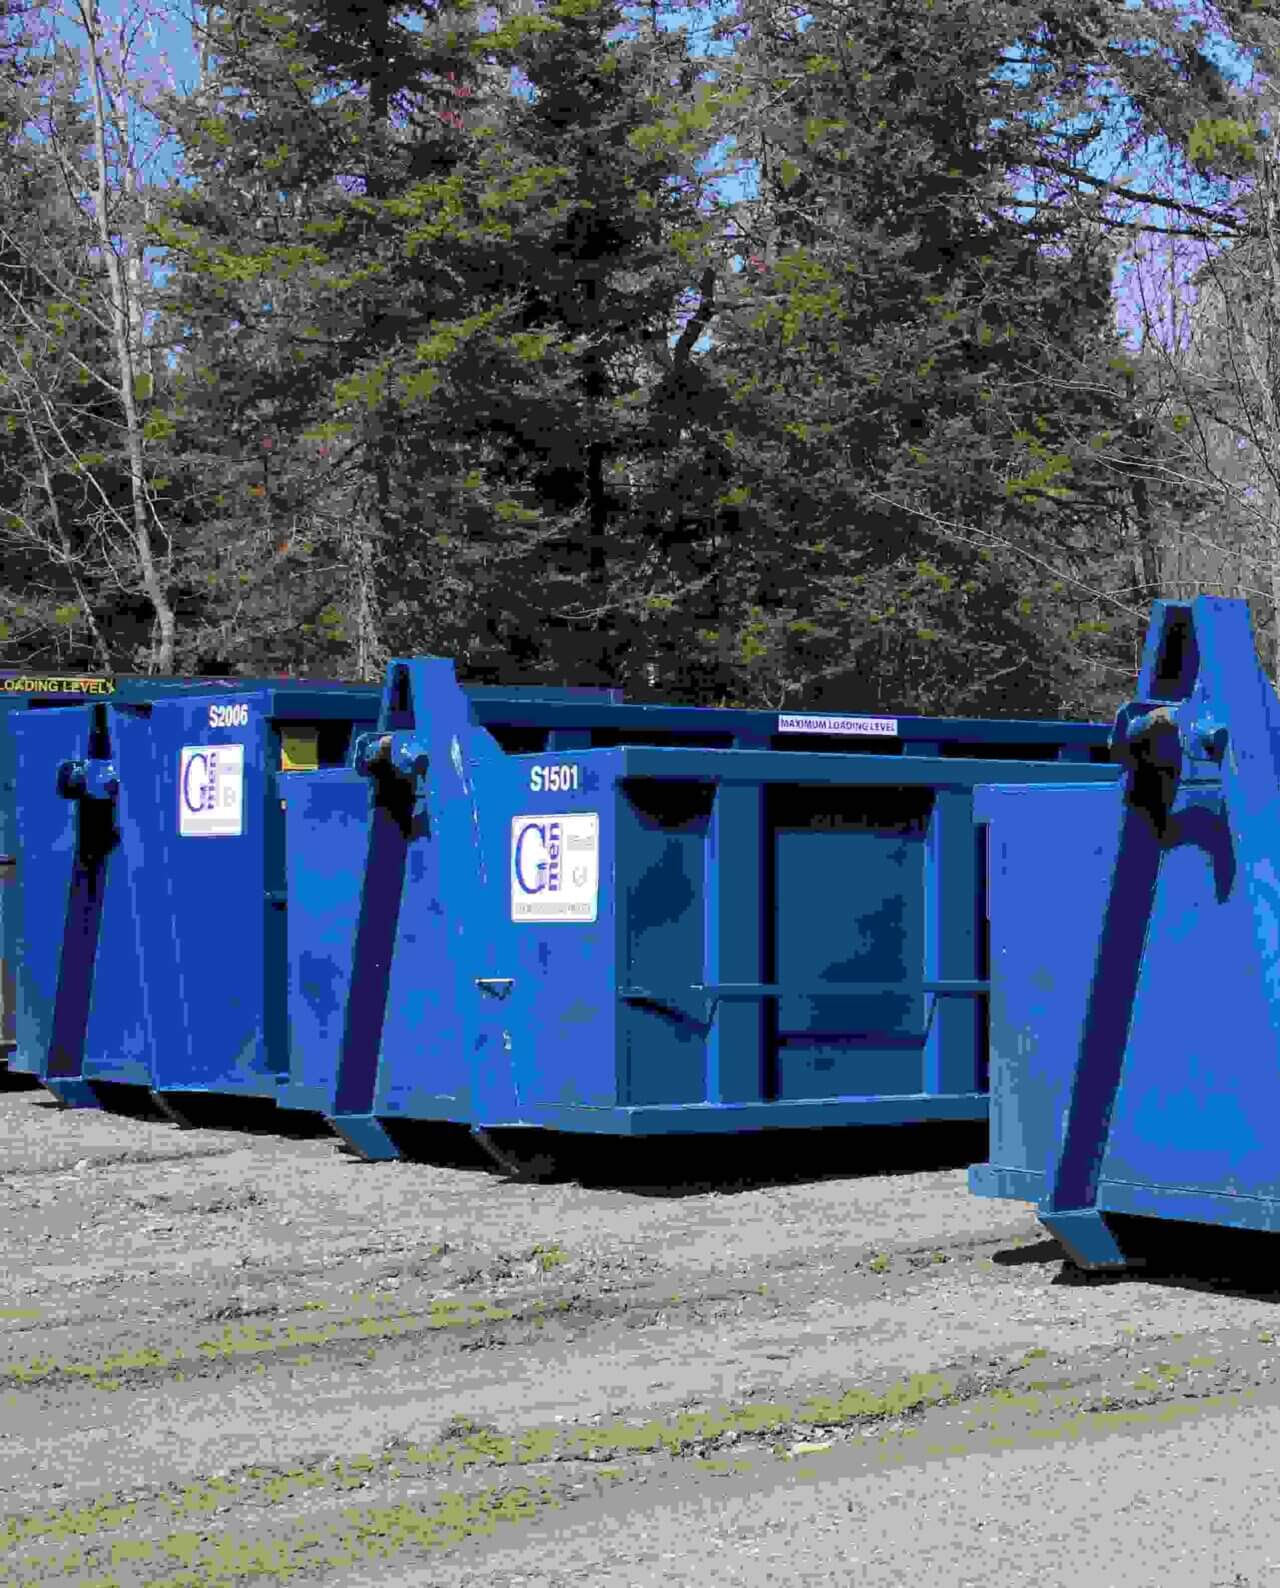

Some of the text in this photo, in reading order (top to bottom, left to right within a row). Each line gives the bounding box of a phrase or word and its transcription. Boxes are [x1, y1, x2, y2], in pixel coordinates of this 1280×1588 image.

[208, 704, 248, 727] S2006
[781, 719, 895, 732] MAXIMUM LOADING LEVEL
[530, 765, 578, 791] S1501
